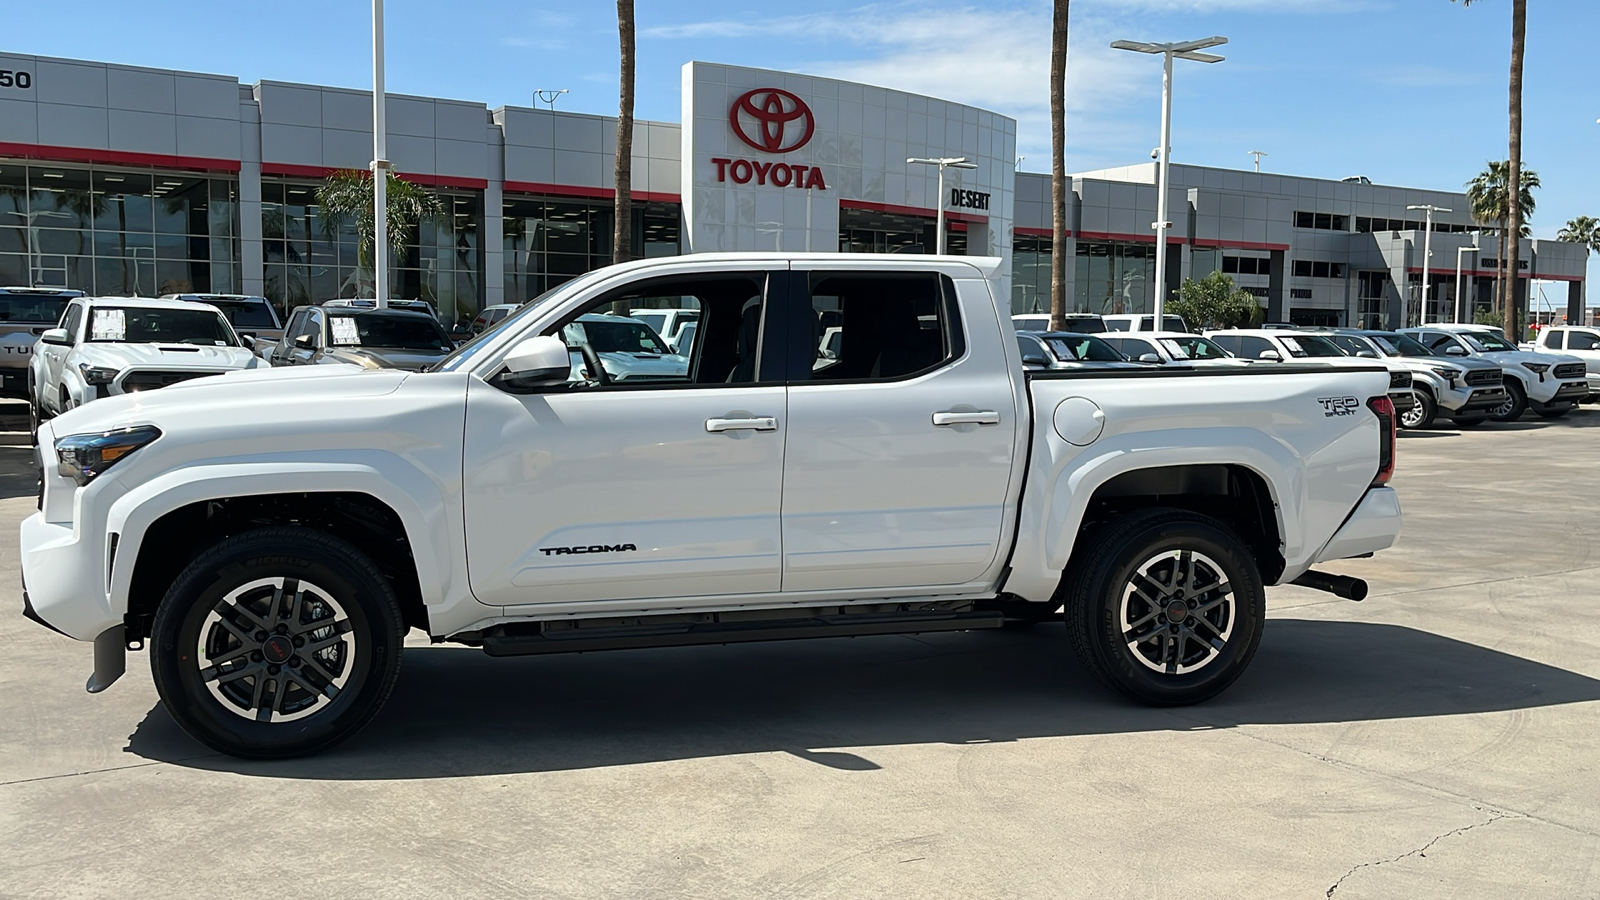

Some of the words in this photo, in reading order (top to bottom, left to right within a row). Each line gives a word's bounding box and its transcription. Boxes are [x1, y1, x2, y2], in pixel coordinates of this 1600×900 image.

[0, 70, 31, 89] 50
[711, 157, 827, 190] TOYOTA
[951, 188, 991, 210] DESERT
[1317, 396, 1360, 414] TRD
[539, 543, 637, 556] TACOMA
